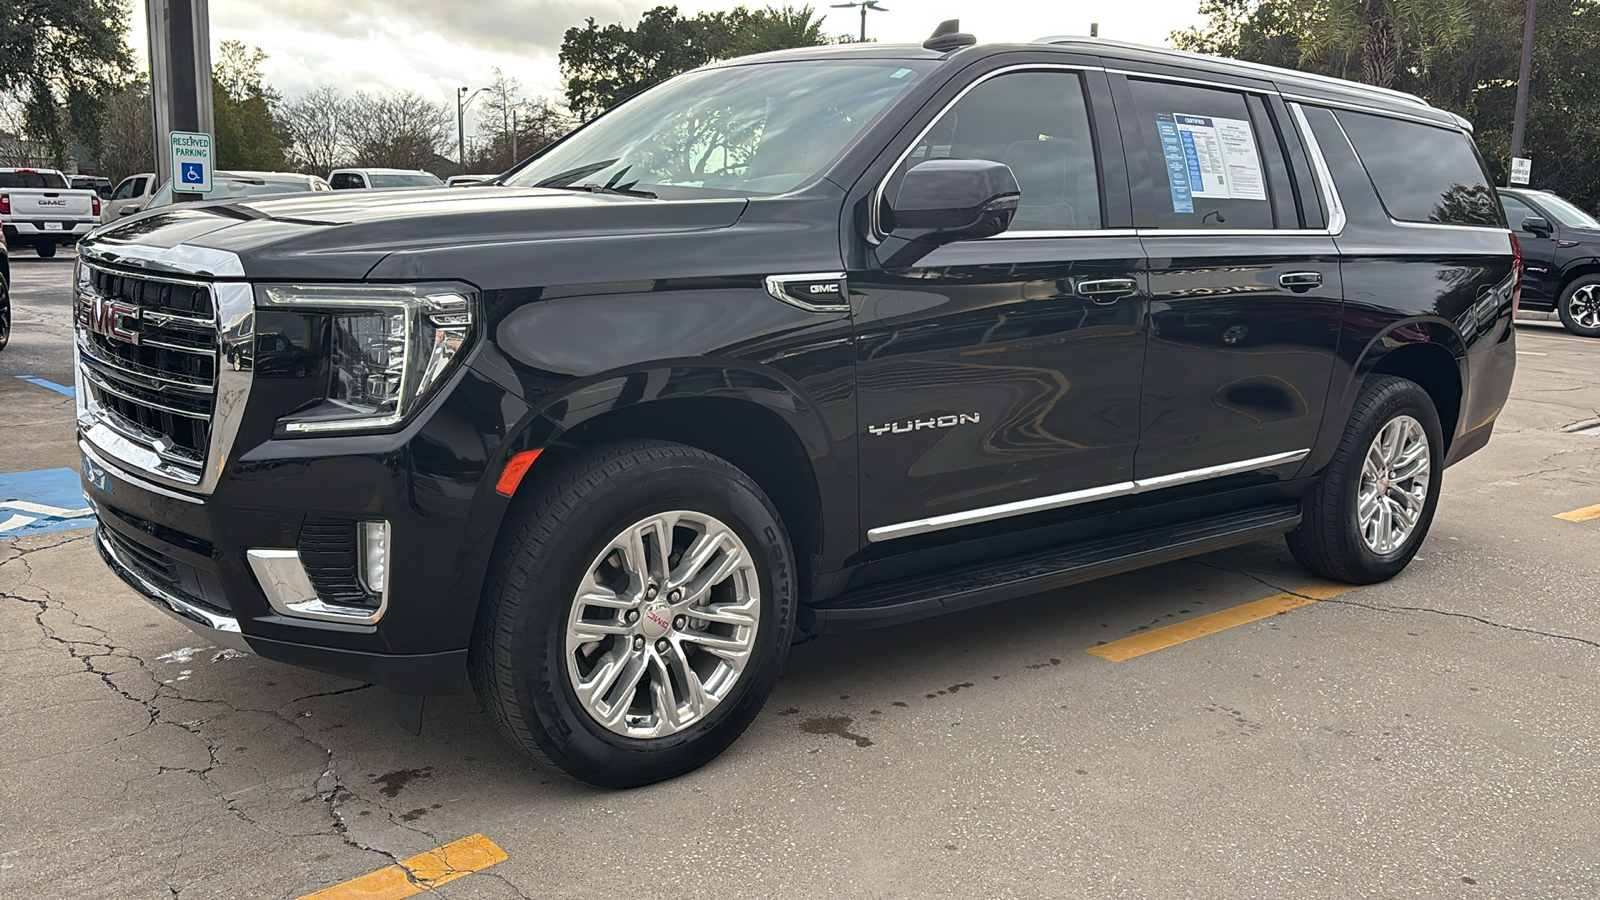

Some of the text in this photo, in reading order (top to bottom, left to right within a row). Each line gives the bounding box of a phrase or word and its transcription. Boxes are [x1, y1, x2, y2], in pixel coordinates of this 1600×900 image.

[173, 137, 209, 148] RESERVED
[175, 147, 207, 158] PARKING
[809, 283, 839, 294] GMC
[77, 293, 140, 346] GMC
[868, 412, 981, 436] YUKON
[646, 611, 669, 630] GMC
